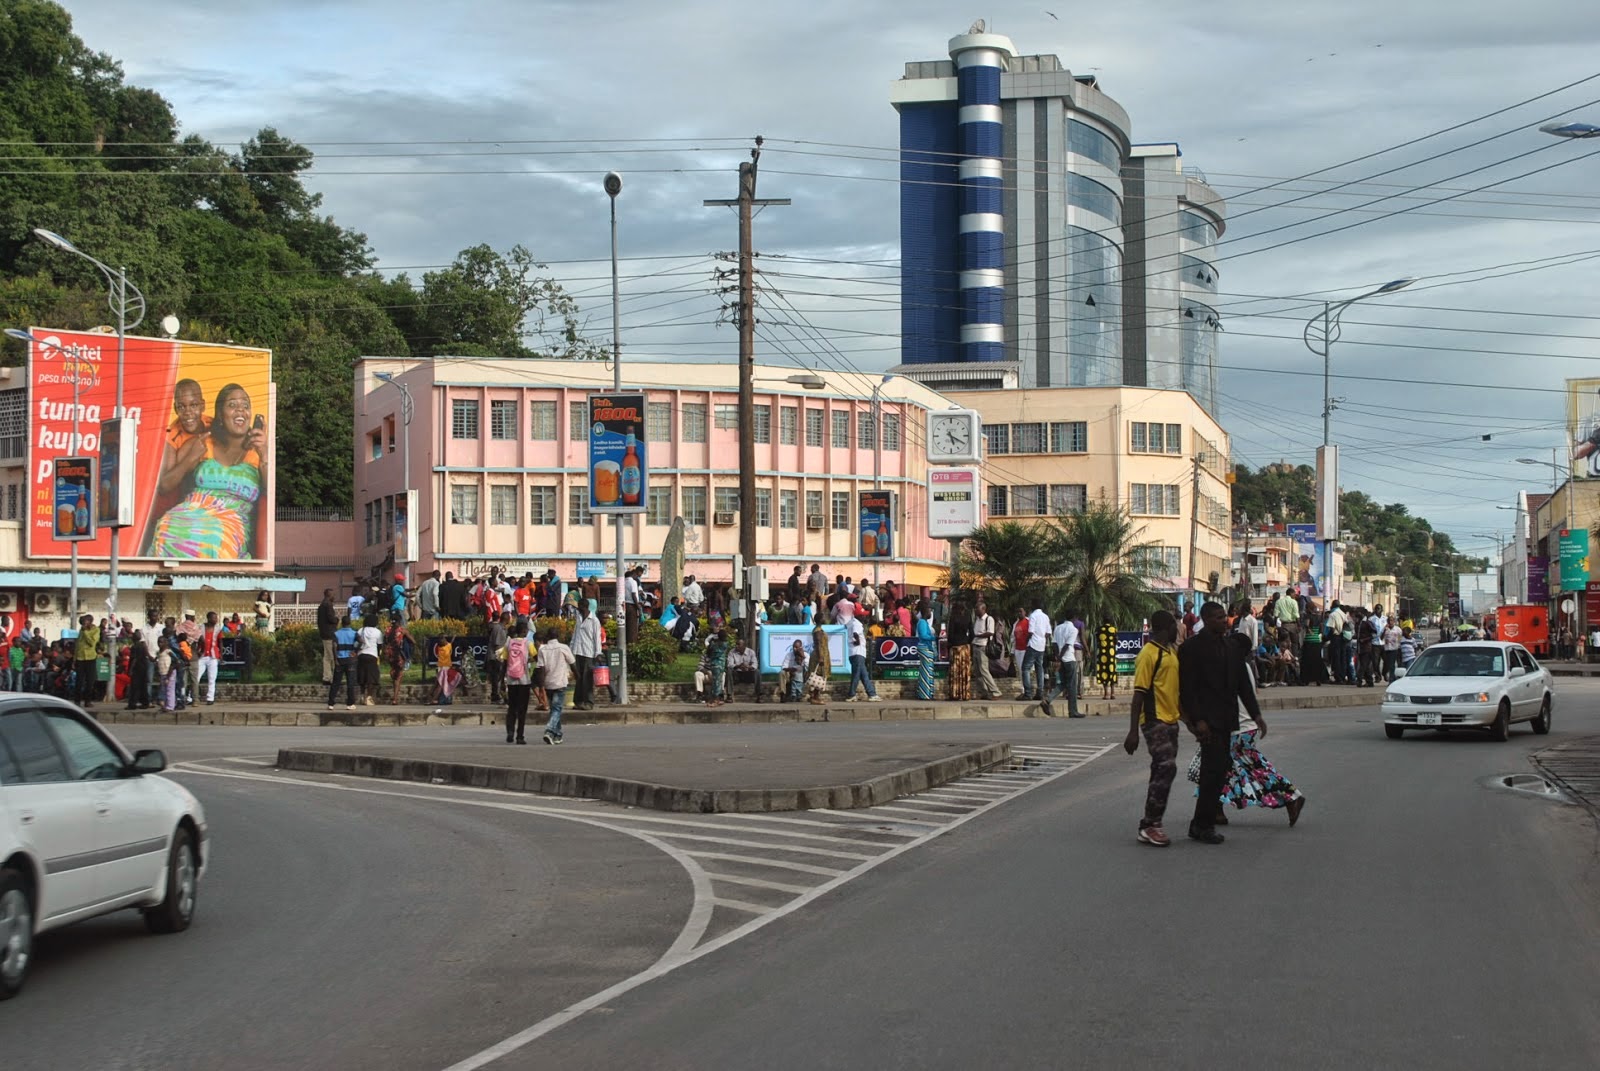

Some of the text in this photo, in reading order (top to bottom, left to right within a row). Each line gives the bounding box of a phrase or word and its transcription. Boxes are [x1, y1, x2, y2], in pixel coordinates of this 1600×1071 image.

[62, 342, 102, 361] airtel
[38, 373, 59, 384] pesa
[39, 397, 101, 423] tuma
[594, 408, 637, 420] 1800
[36, 519, 53, 528] Airte
[1115, 637, 1142, 651] pepsi
[454, 645, 488, 657] pps
